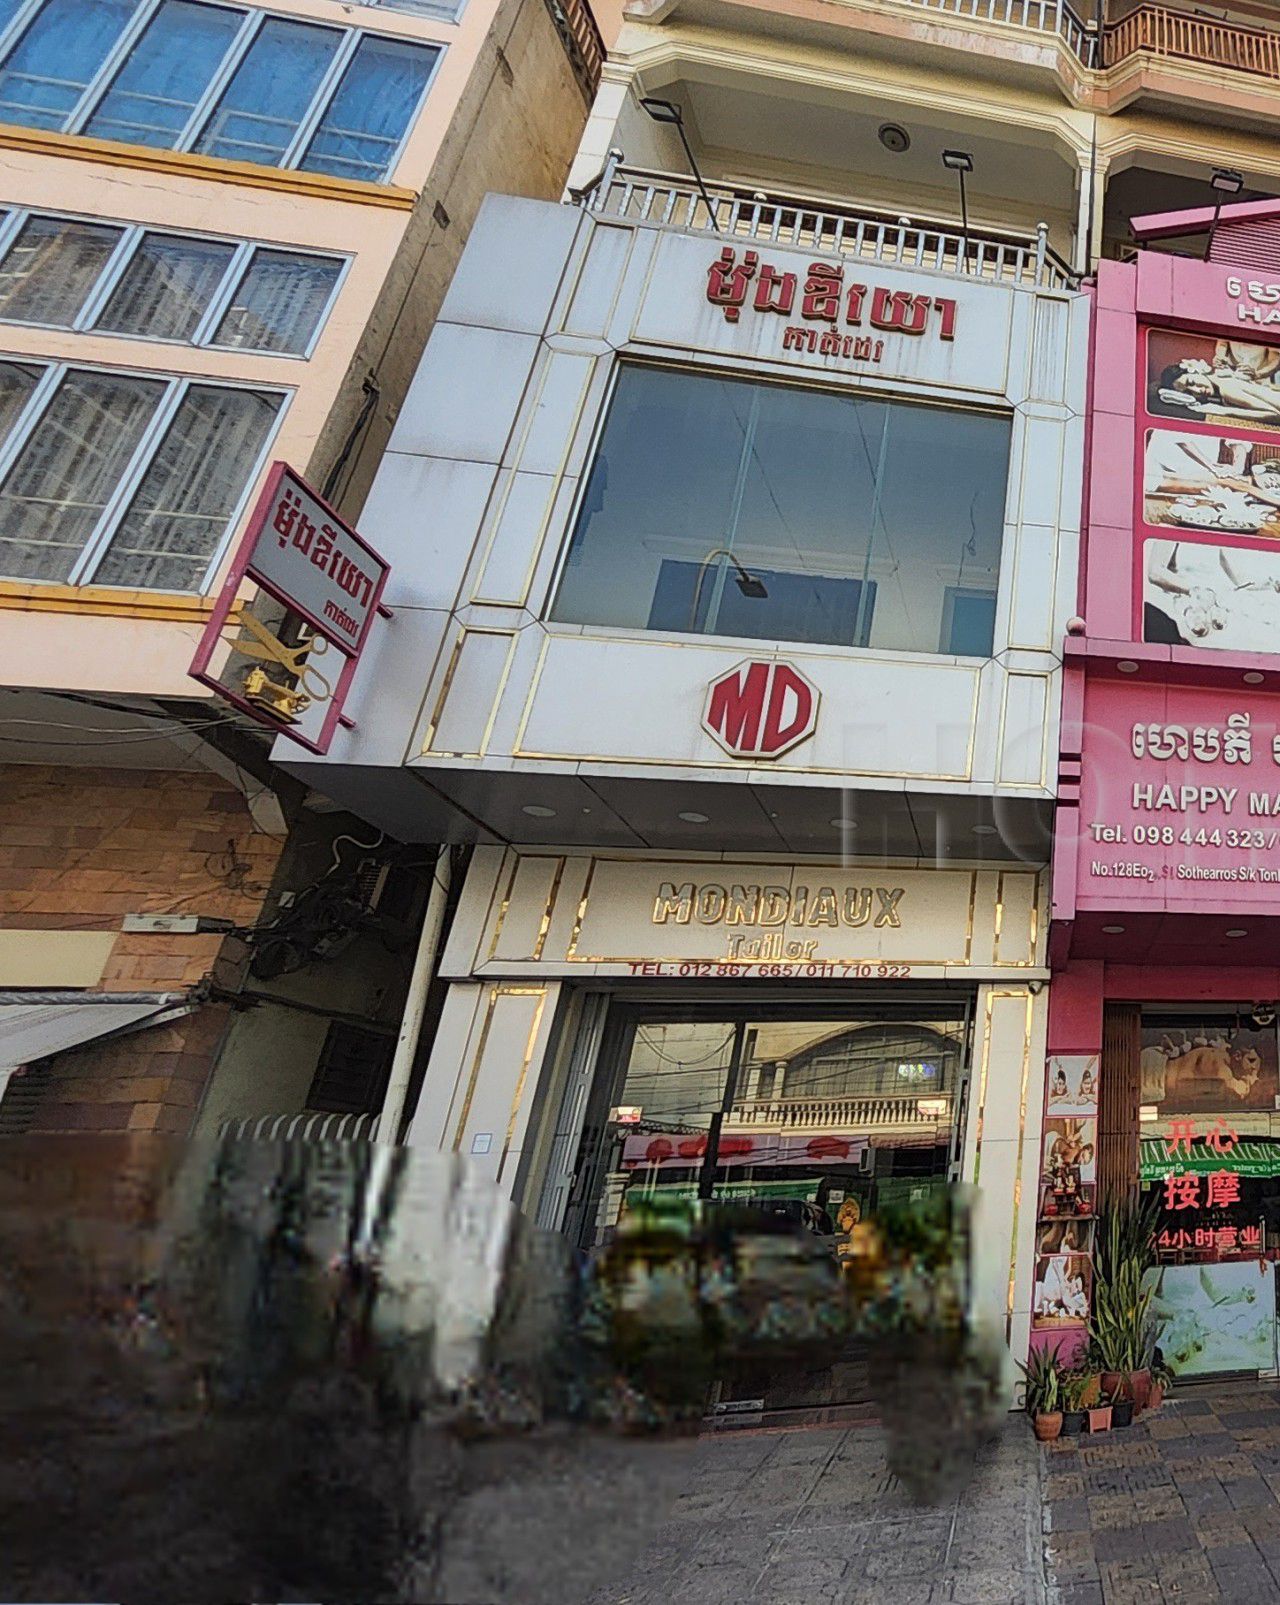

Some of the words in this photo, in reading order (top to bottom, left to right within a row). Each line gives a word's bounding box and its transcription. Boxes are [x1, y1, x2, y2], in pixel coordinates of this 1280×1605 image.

[707, 662, 812, 752] MD
[1131, 783, 1238, 814] HAPPY
[1090, 823, 1128, 844] Tel.
[1132, 824, 1175, 846] 098
[1179, 827, 1223, 848] 444
[652, 881, 906, 928] MONDIAUX
[727, 933, 818, 960] Tailor
[628, 962, 675, 976] TEL:
[678, 963, 711, 977] 012
[716, 964, 750, 977] 867
[841, 965, 872, 978] 710
[877, 966, 912, 979] 922
[1164, 1117, 1239, 1154] 开心
[1163, 1168, 1241, 1211] 按摩
